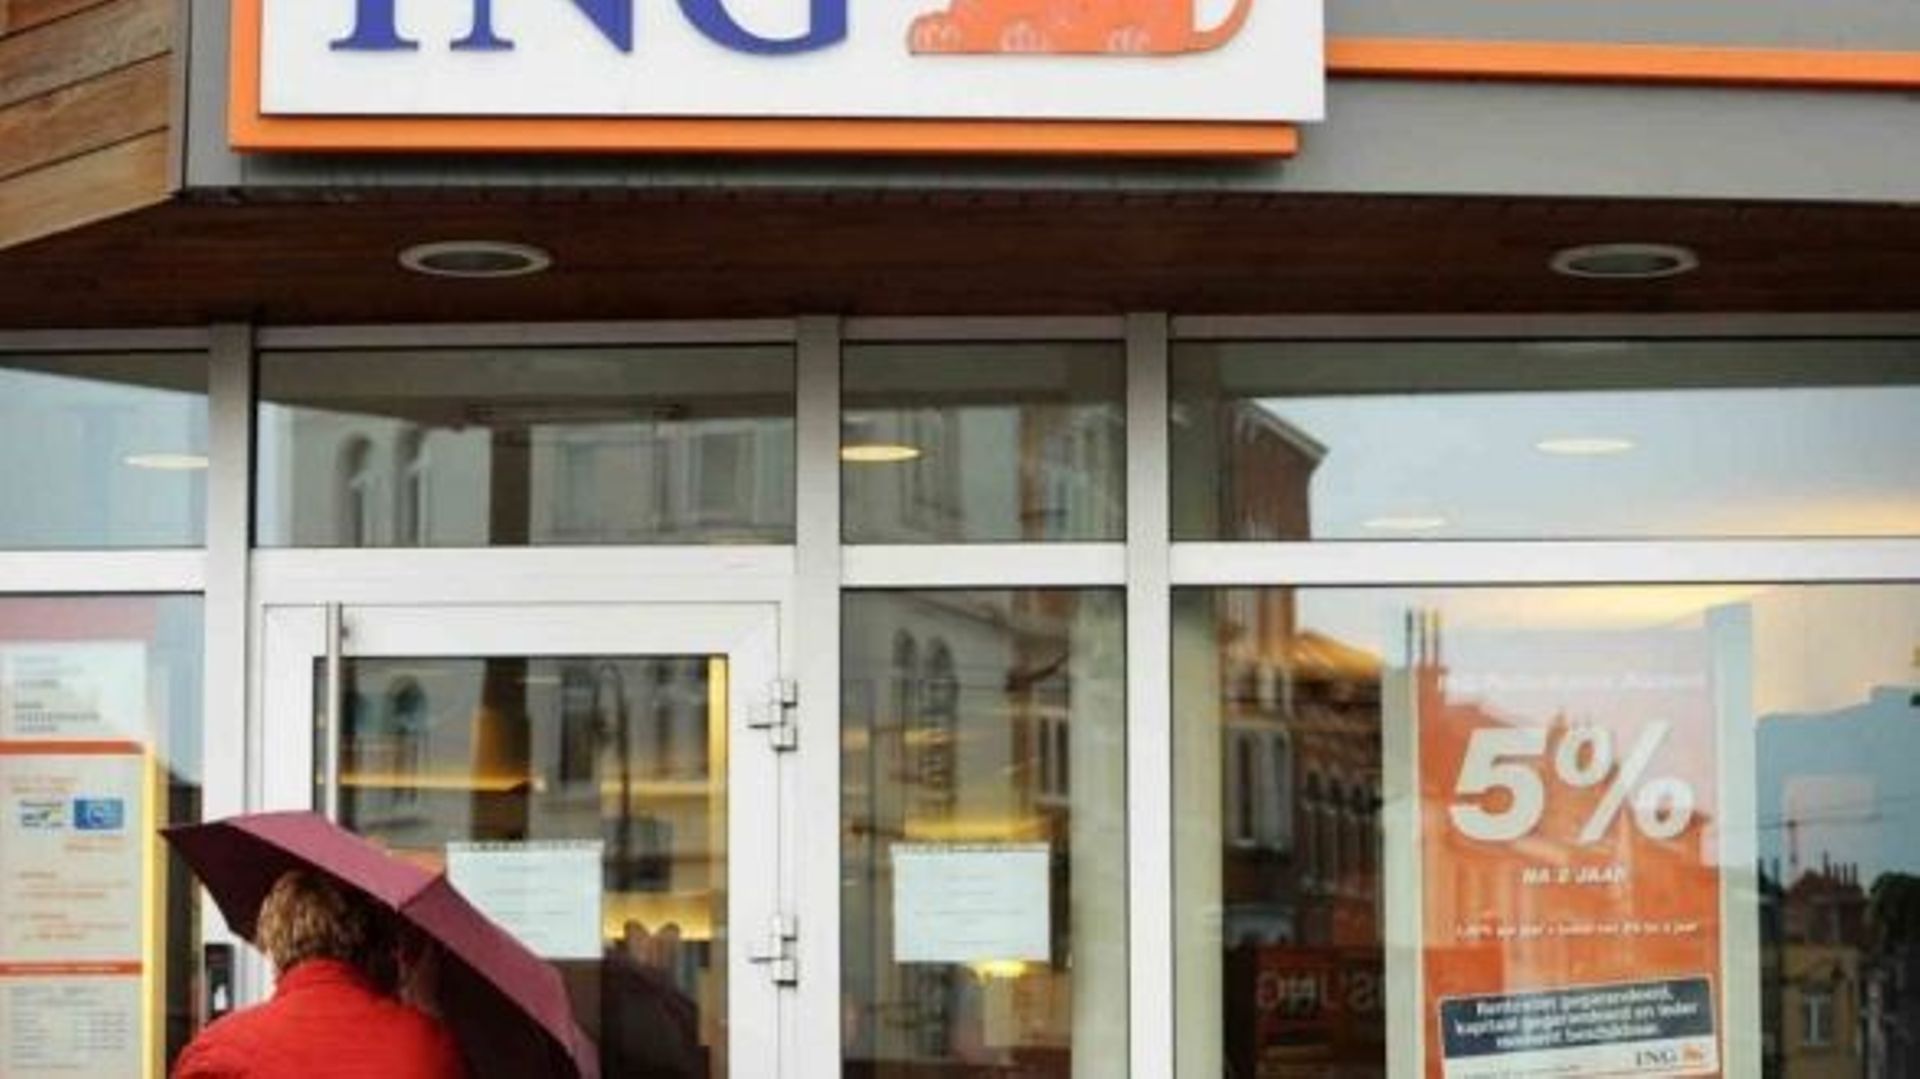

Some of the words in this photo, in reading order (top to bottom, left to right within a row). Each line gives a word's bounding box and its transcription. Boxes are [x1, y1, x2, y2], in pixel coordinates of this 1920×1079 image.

[1449, 720, 1695, 846] 5%
[1522, 866, 1550, 884] NA
[1635, 1049, 1678, 1067] ING
